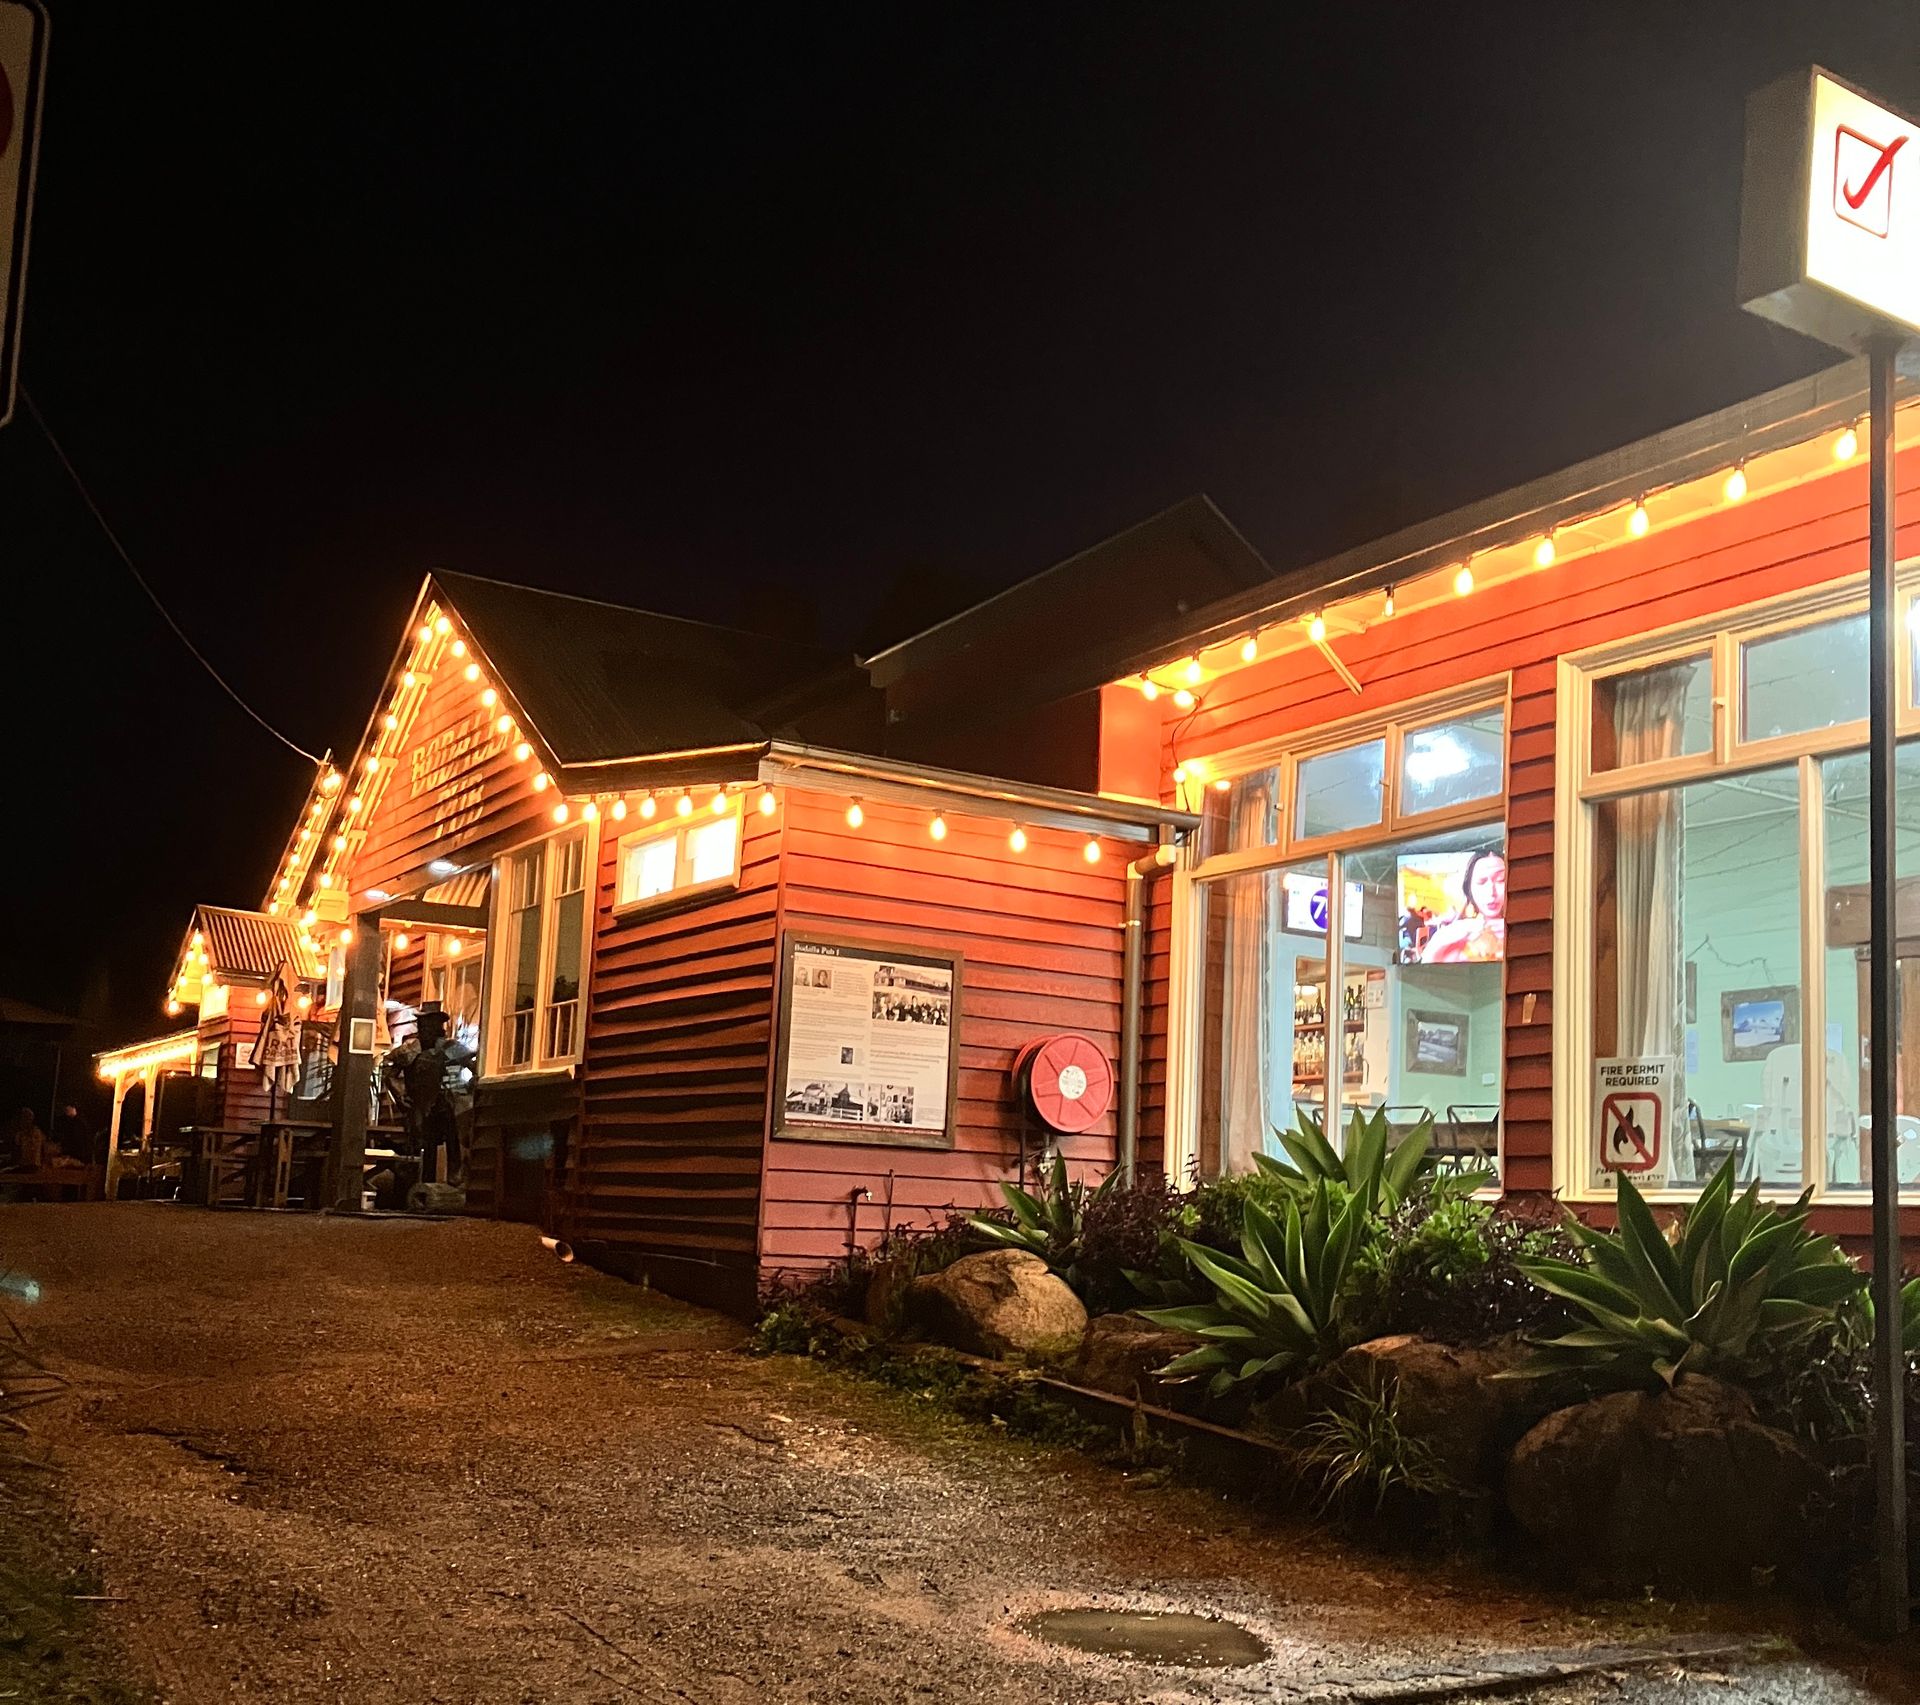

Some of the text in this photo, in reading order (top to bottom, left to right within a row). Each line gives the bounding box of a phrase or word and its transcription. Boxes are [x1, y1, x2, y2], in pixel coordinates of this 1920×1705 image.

[1600, 1064, 1665, 1076] FIRE PERMIT
[1605, 1076, 1659, 1086] REQUIRED
